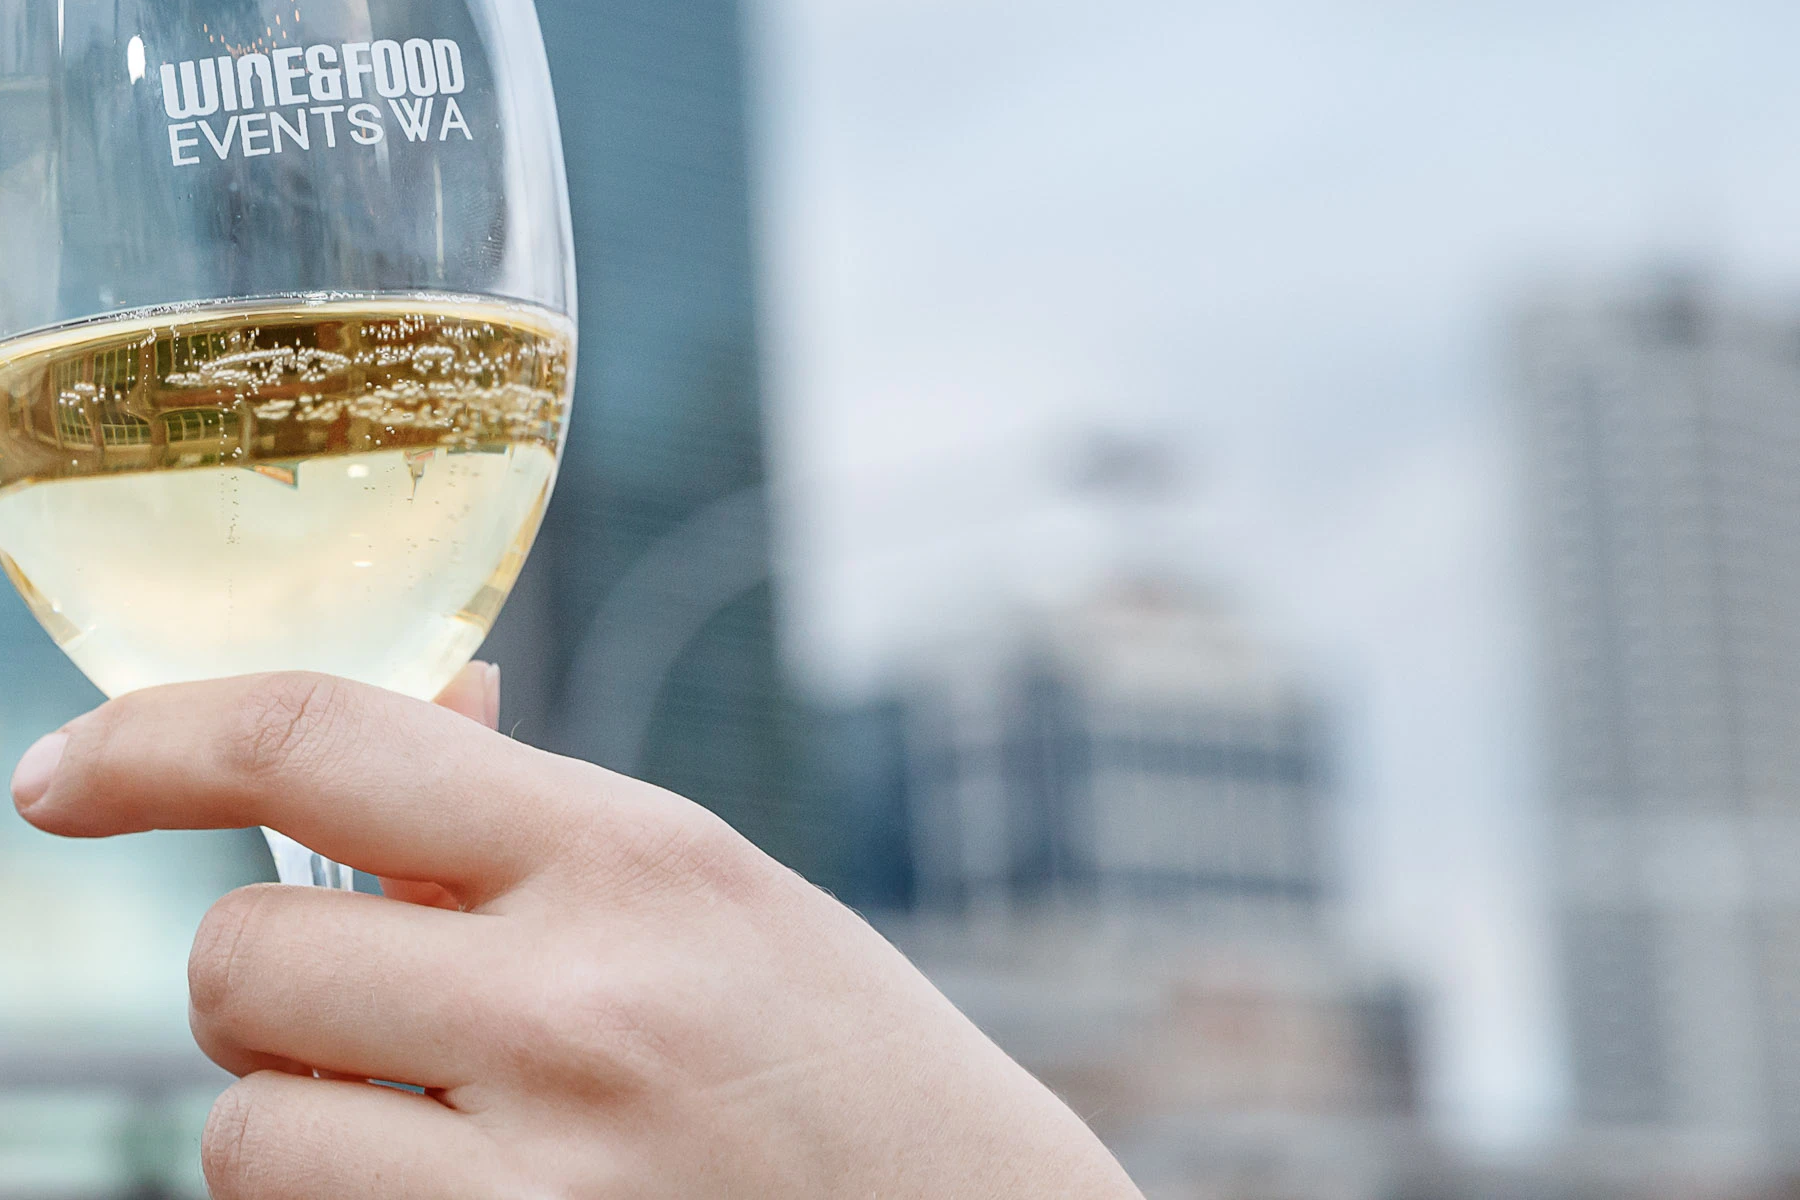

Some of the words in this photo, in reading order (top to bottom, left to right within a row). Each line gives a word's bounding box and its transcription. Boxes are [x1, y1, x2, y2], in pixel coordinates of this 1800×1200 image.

[159, 38, 465, 119] WINE&FOOD
[167, 103, 384, 167] EVENTS
[388, 97, 473, 142] WA
